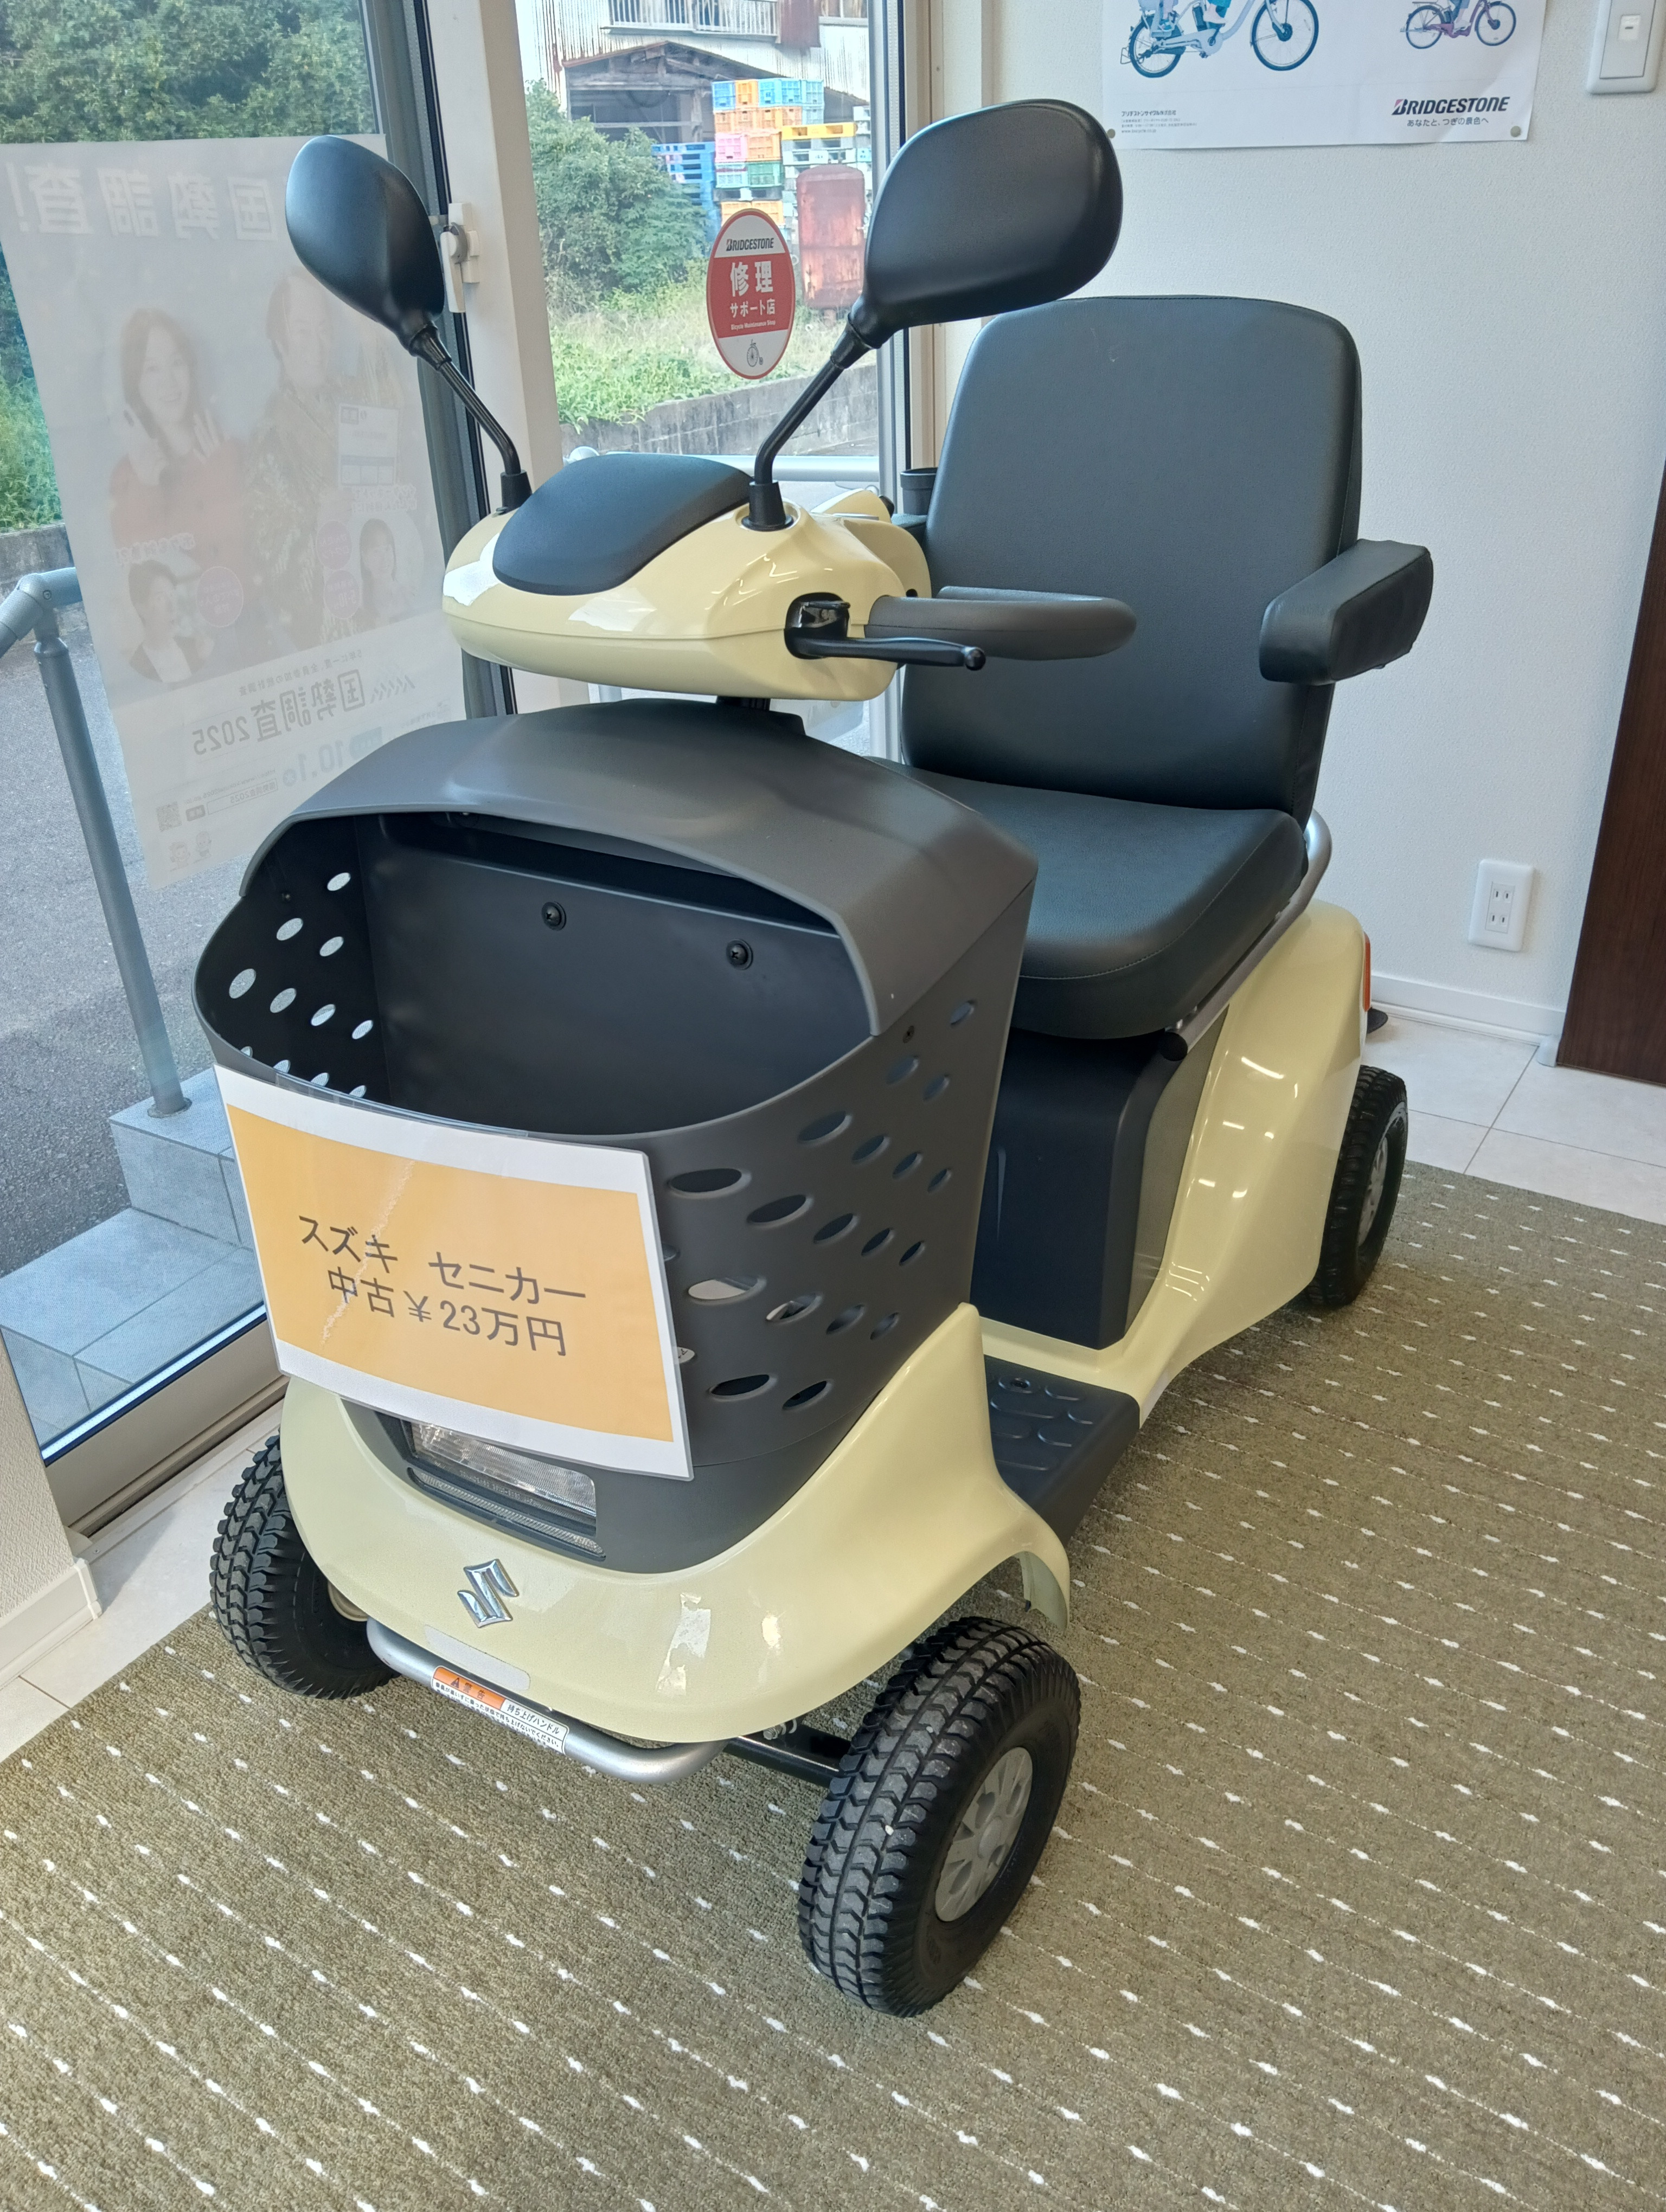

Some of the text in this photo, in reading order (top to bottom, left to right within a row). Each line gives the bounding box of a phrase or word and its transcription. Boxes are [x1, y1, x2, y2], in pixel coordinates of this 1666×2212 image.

[1392, 97, 1511, 115] BRIDGESTONE
[1407, 117, 1489, 127] あなたと、つぎの景色へ
[726, 237, 774, 252] BRIDGESTONE
[730, 260, 773, 297] 修理
[729, 299, 776, 318] サポート店
[298, 1214, 587, 1306] スズキ セニカー
[327, 1267, 567, 1357] 中古¥23万円
[463, 1682, 485, 1700] 警告
[507, 1704, 560, 1735] 持ち上げハンドル
